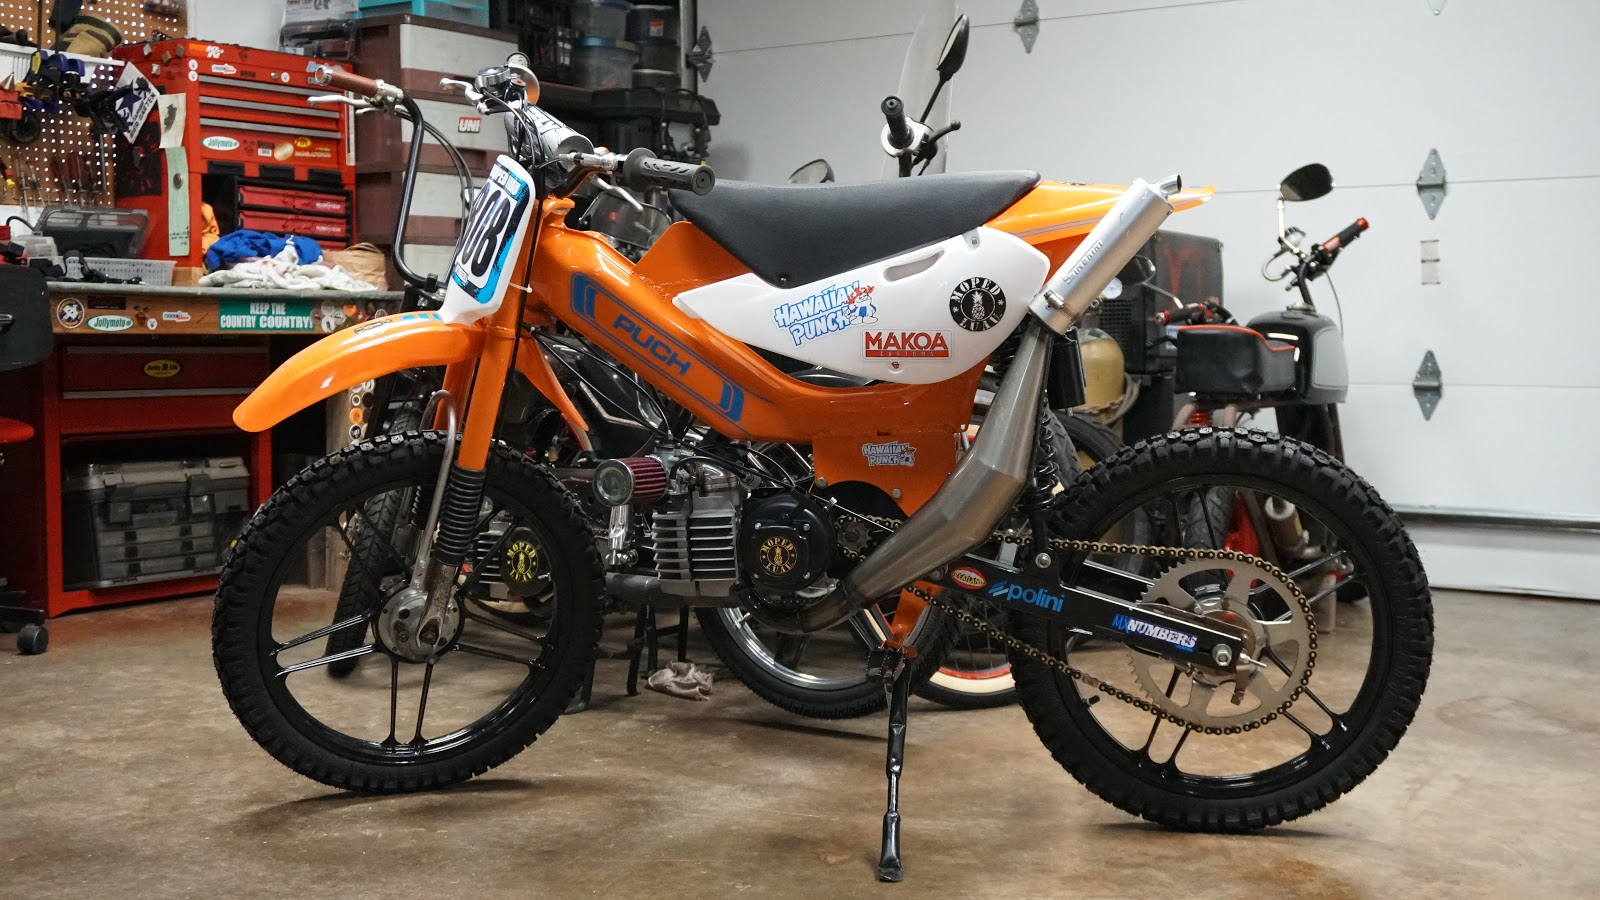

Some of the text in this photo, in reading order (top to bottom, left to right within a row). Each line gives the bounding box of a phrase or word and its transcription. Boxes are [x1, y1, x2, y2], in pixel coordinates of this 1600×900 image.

[458, 118, 480, 132] UNI
[950, 277, 1001, 303] MOPED
[250, 302, 286, 315] KEEP THE
[94, 317, 126, 329] Jollymoto
[220, 315, 314, 330] COUNTRY COUNTRY!
[789, 304, 851, 346] PUNCH
[959, 313, 1003, 332] LUAU
[613, 314, 691, 376] PUCH
[865, 331, 948, 350] MAKOA
[869, 455, 901, 466] PUNCH
[507, 541, 536, 558] MOPED
[761, 537, 794, 552] MOPED
[764, 561, 795, 574] LUAU
[1006, 583, 1065, 613] polini
